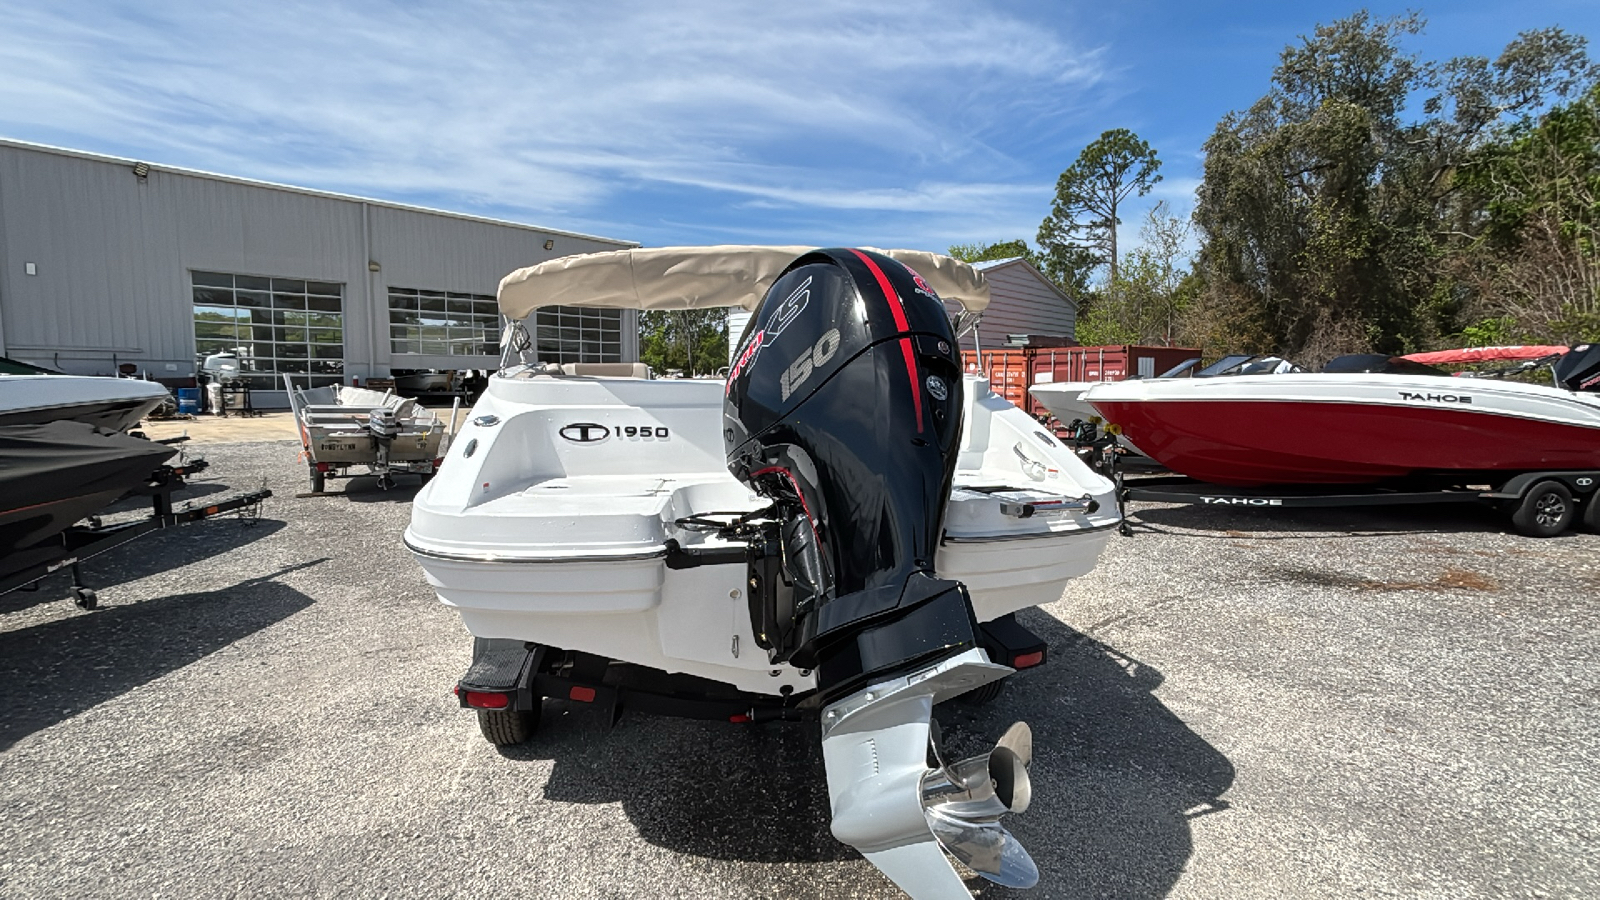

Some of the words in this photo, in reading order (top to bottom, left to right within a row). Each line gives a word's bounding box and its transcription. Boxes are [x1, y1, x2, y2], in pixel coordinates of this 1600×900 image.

[780, 328, 840, 403] 150
[1398, 391, 1473, 404] TAHOE
[614, 426, 669, 438] 1950
[1199, 496, 1283, 506] TAHOE
